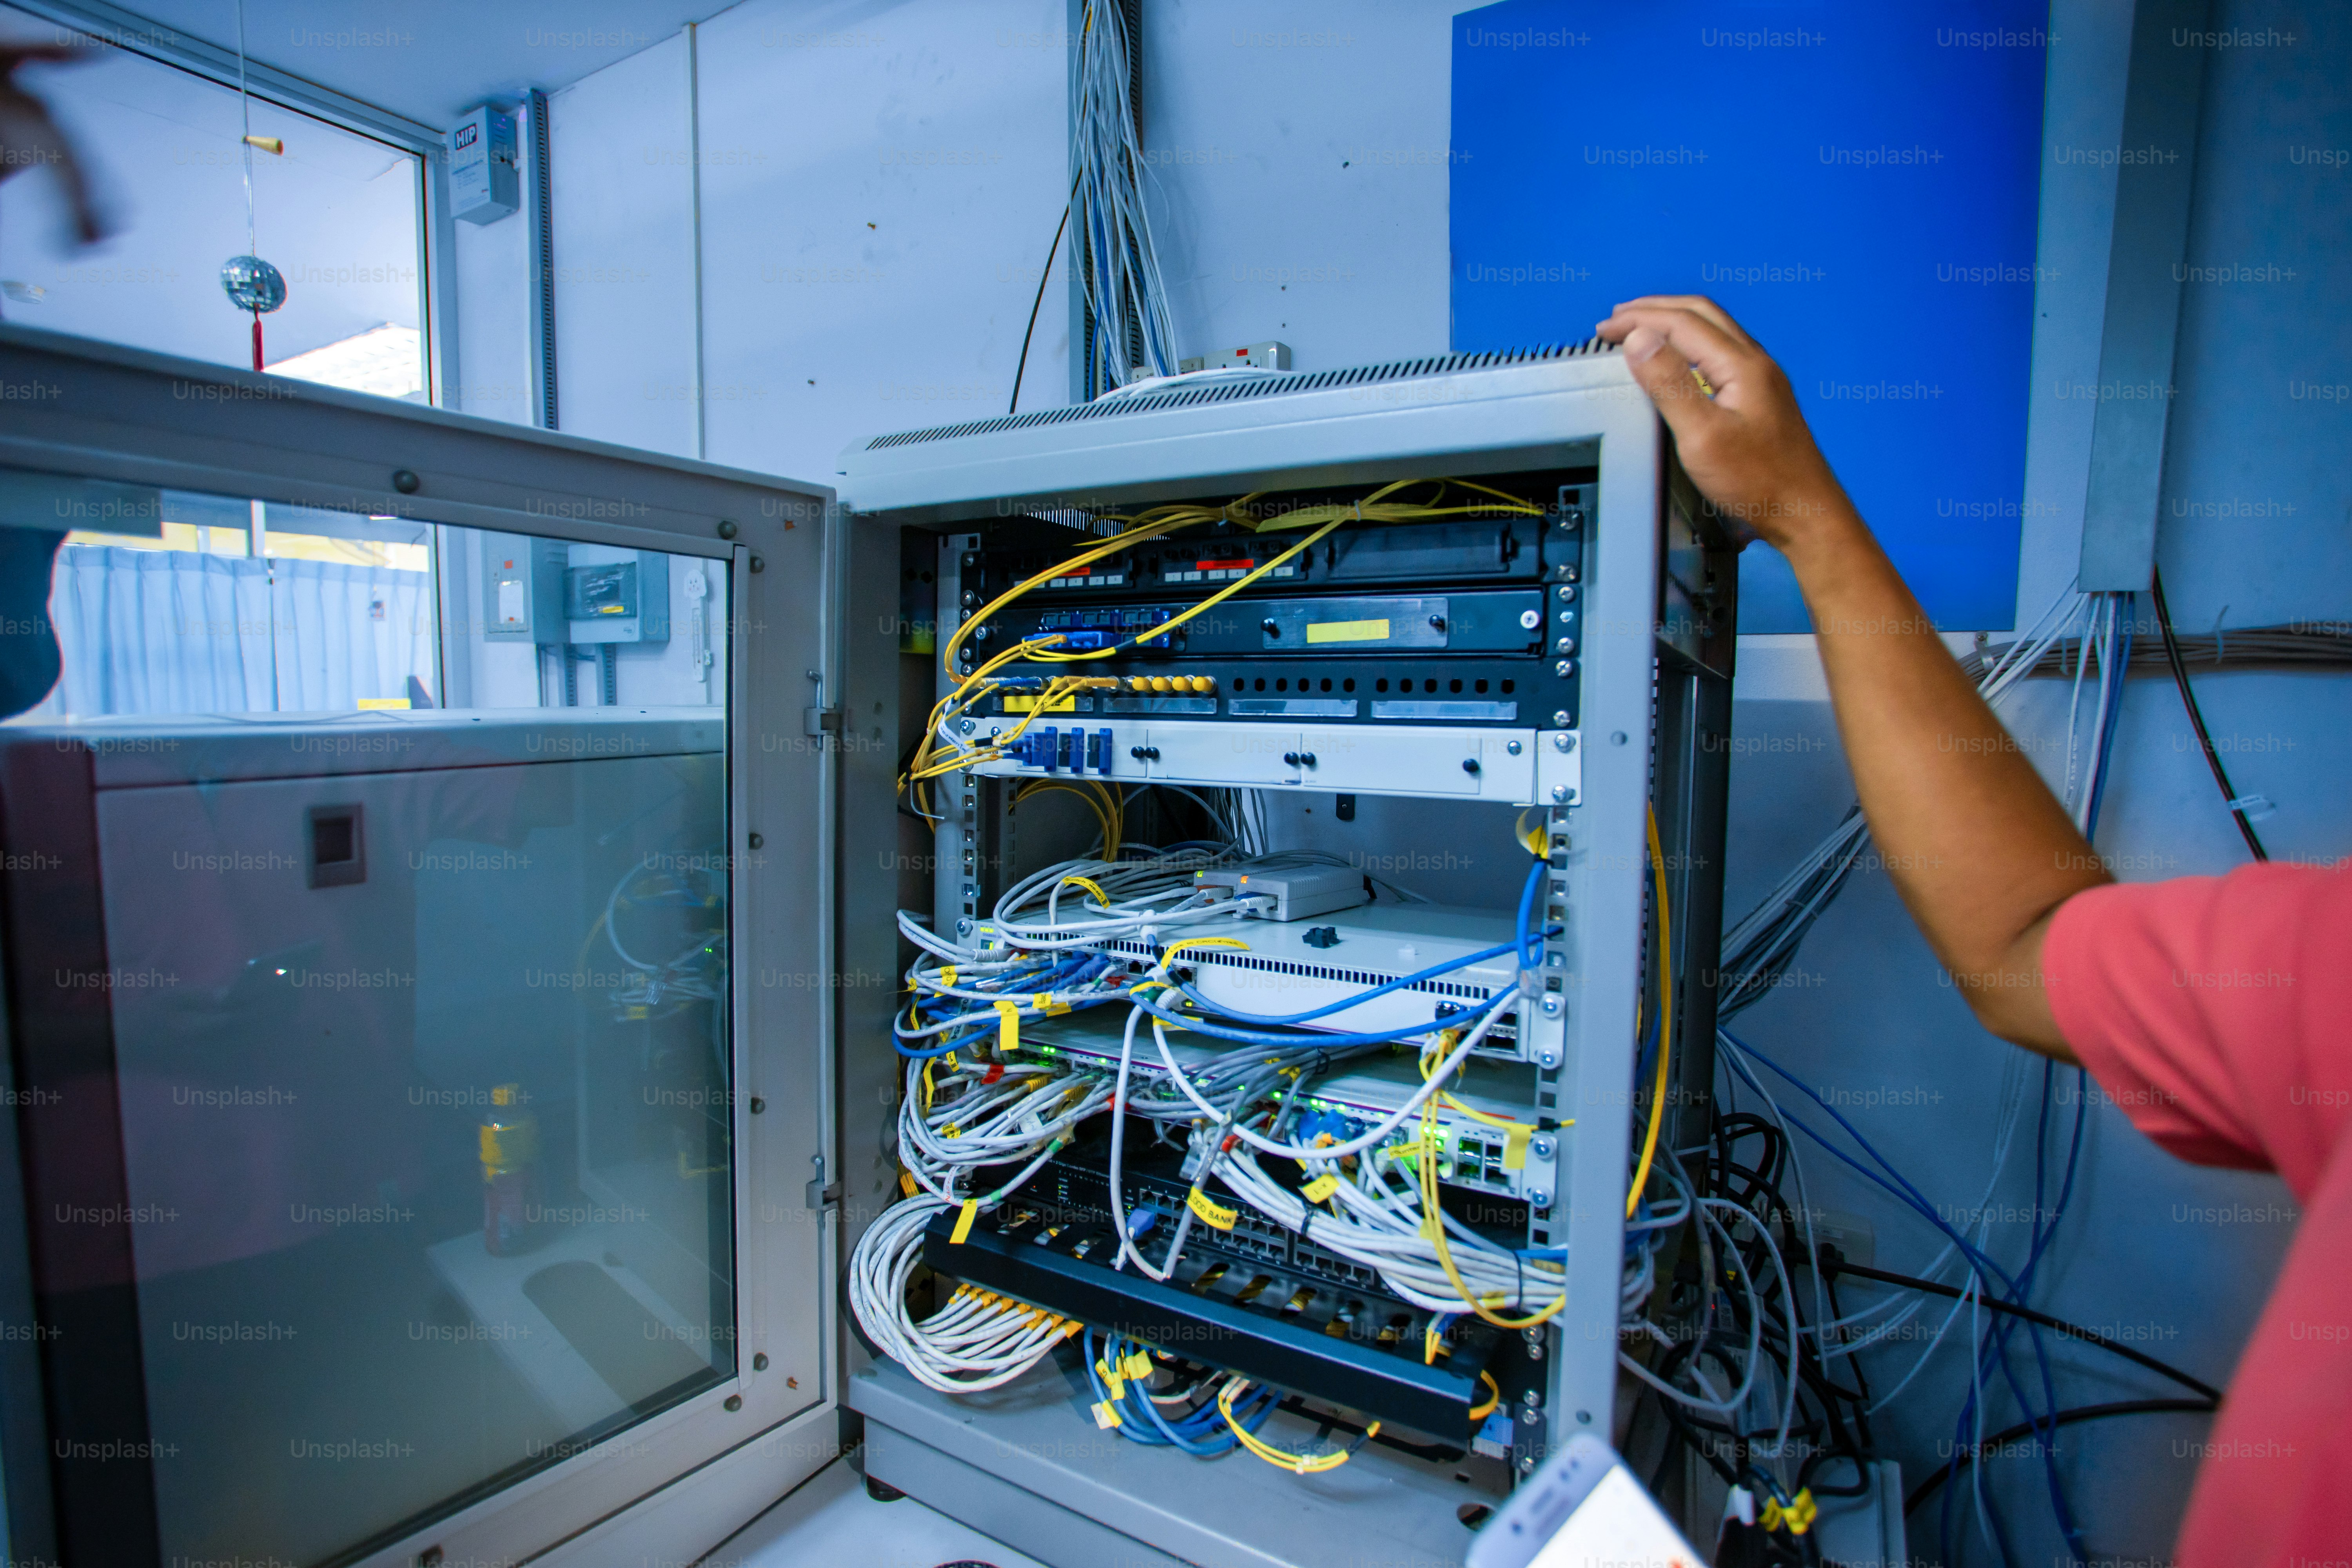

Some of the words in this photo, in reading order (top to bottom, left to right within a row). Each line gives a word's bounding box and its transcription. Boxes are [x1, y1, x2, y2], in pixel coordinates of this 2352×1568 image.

[456, 126, 476, 149] HIP
[1190, 1195, 1206, 1212] LOOD
[1208, 1210, 1233, 1224] BANK
